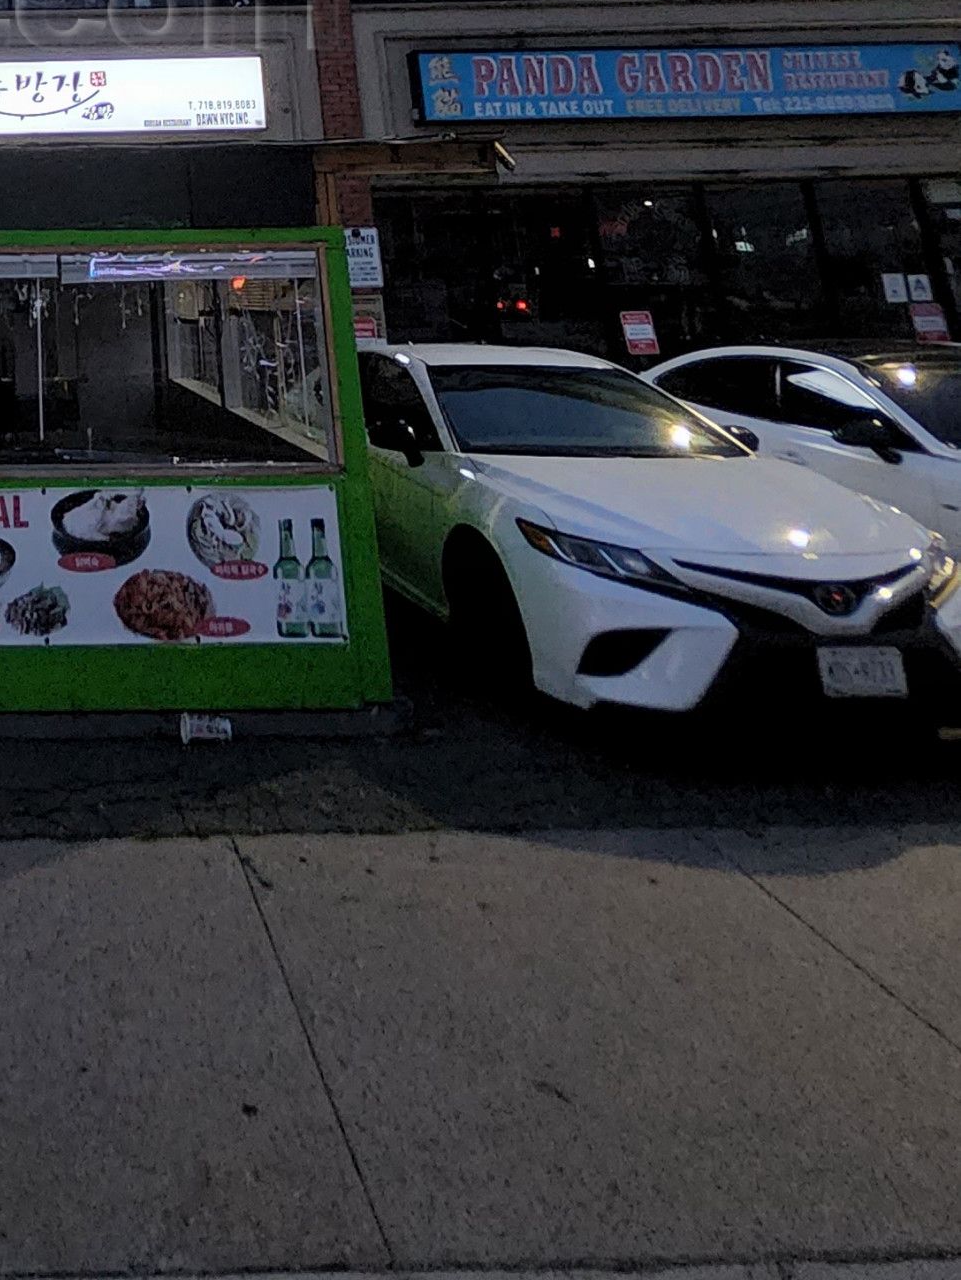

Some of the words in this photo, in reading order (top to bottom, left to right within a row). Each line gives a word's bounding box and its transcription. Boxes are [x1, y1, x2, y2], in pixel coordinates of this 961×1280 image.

[781, 51, 862, 70] CHINESE
[472, 55, 603, 97] PANDA
[615, 50, 773, 95] GARDEN
[783, 70, 889, 91] RESTAURANT
[474, 101, 503, 117] EAT
[505, 101, 523, 116] IN
[525, 101, 536, 116] &
[540, 100, 579, 116] TAKE
[585, 99, 614, 115] OUT
[626, 98, 663, 114] FREE
[668, 97, 741, 113] DELIVERY
